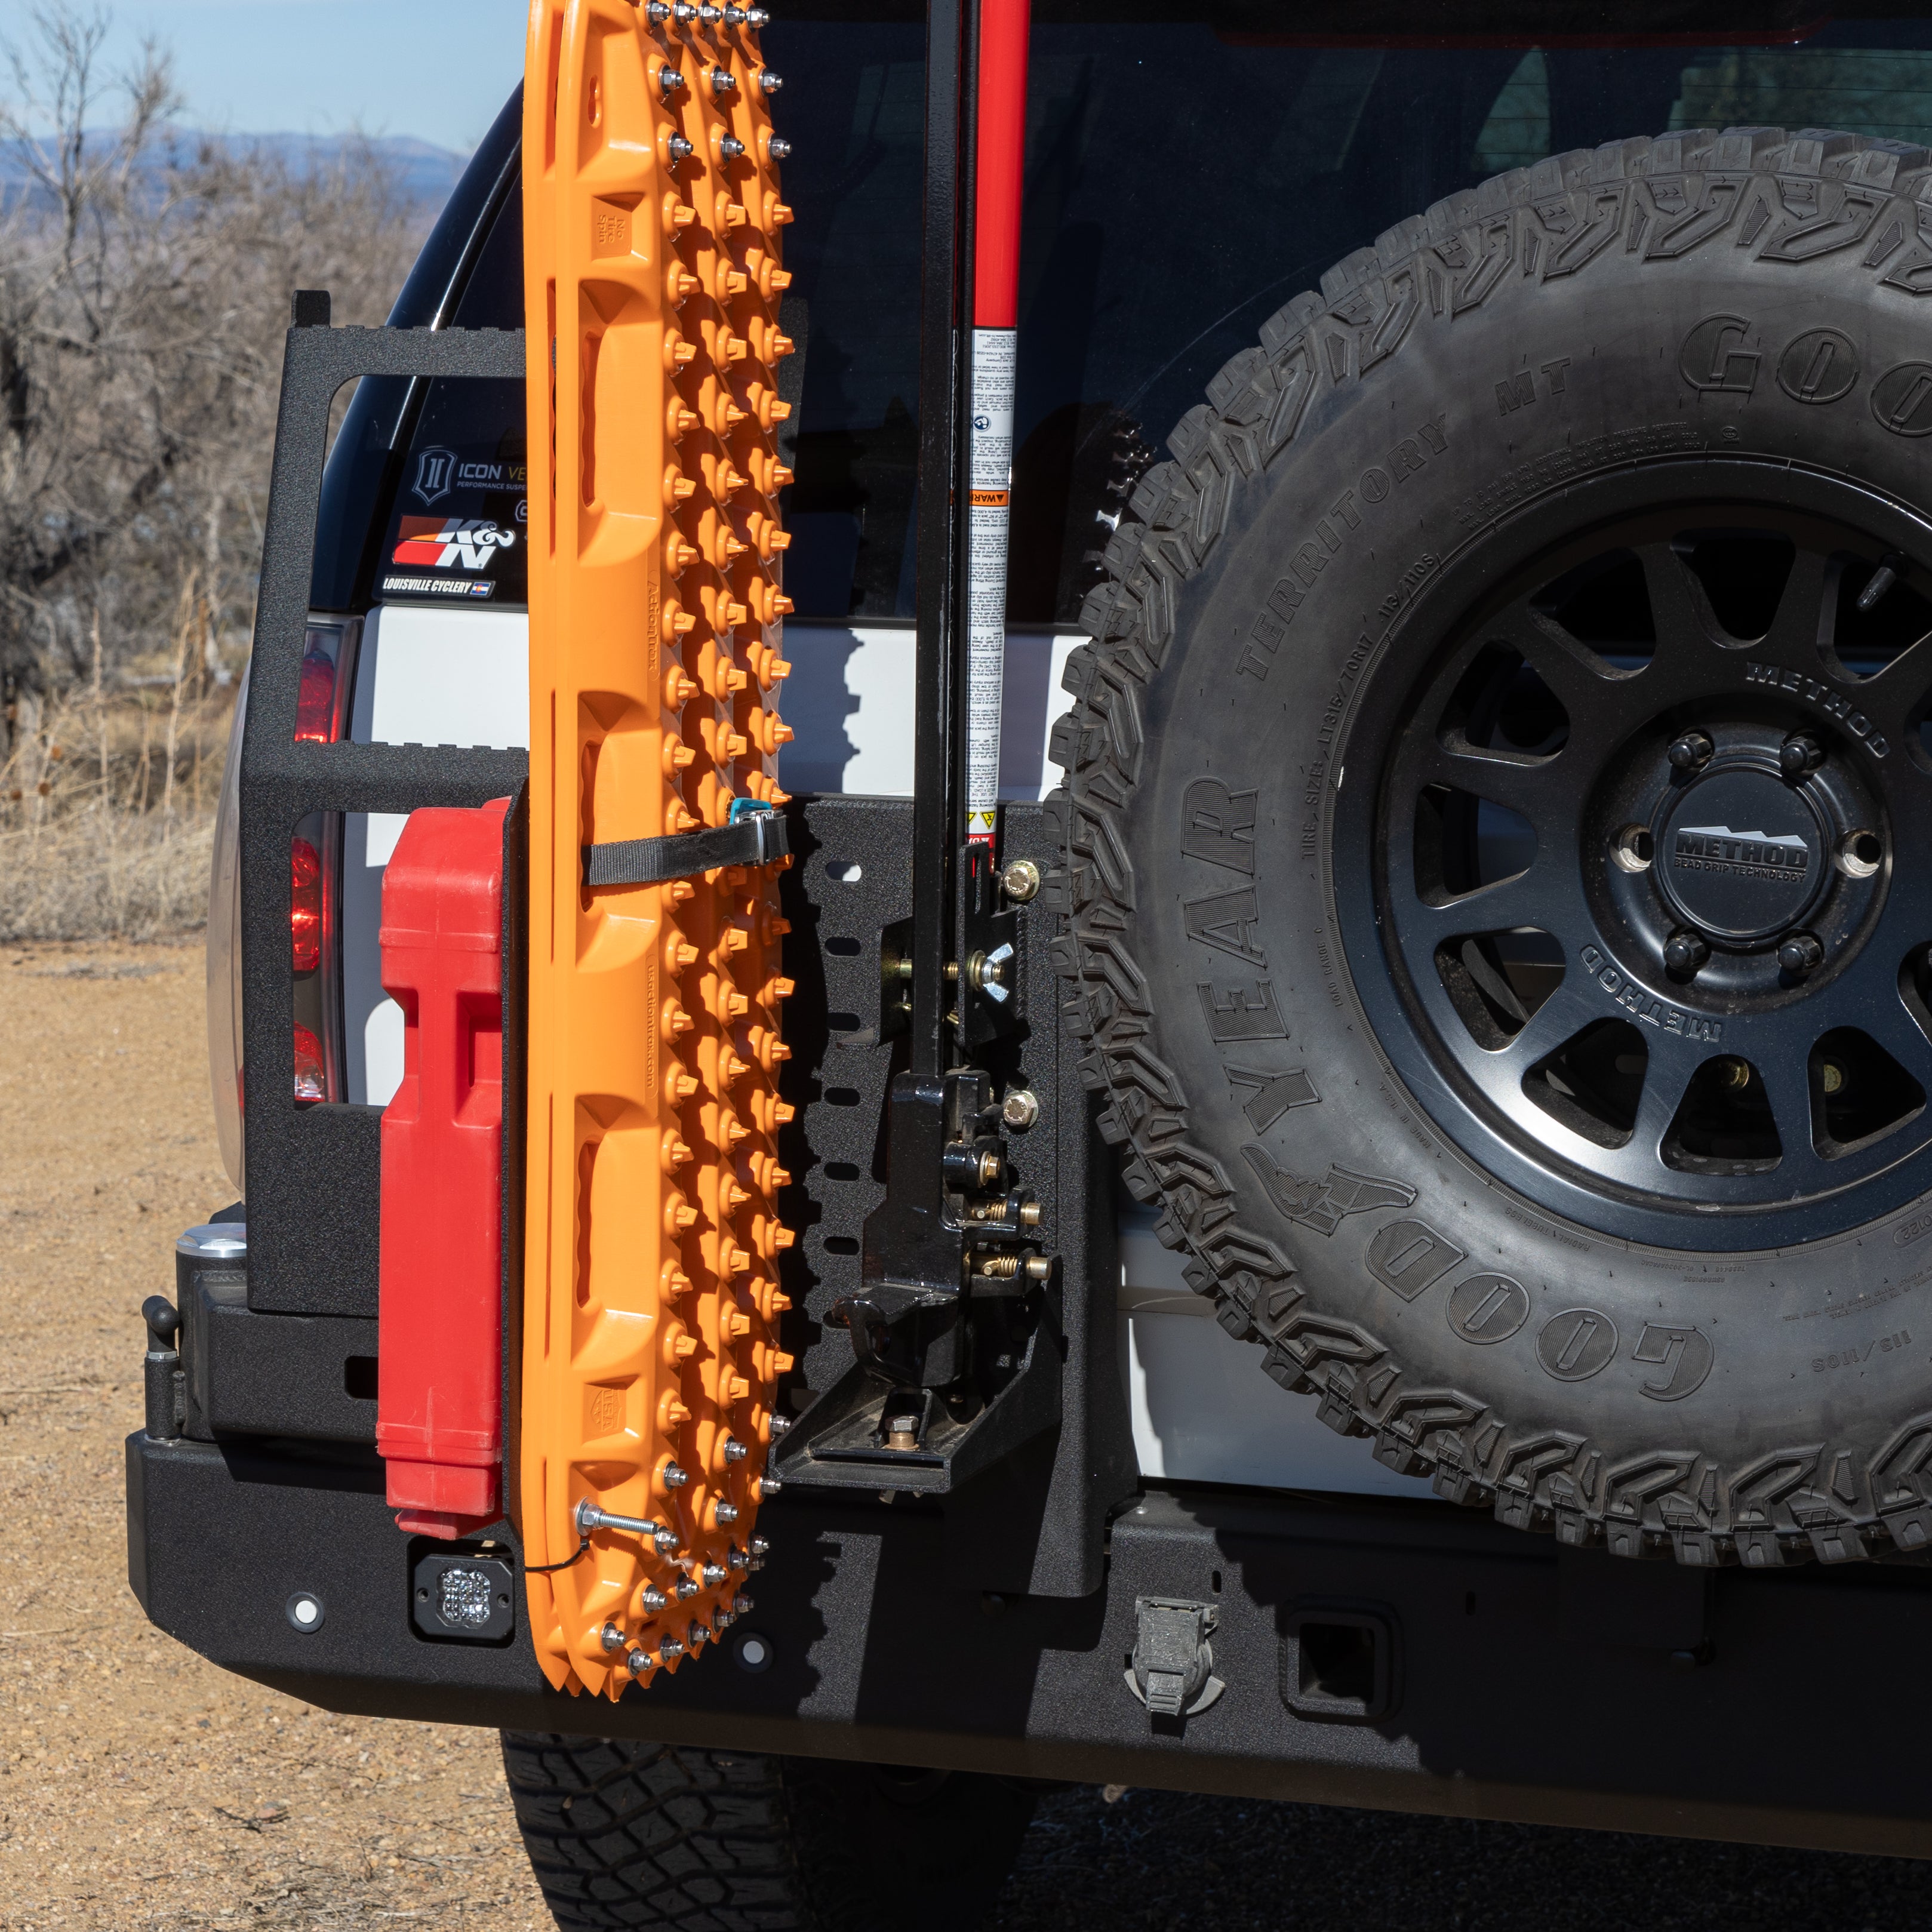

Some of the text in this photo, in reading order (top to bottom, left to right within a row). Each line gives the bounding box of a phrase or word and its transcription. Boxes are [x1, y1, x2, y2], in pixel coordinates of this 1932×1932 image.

[597, 214, 608, 244] Spin
[608, 215, 617, 243] Tire
[617, 219, 626, 240] No
[1536, 447, 1572, 466] ADDITIONAL
[1575, 434, 1608, 449] INFLATION
[1613, 426, 1647, 438] PRESSURE
[1652, 422, 1687, 432] PERMITTED
[457, 481, 504, 490] PERFORMANCE
[458, 463, 502, 479] ICON
[1476, 497, 1493, 512] LOAD
[1681, 431, 1698, 441] COLD
[1236, 413, 1449, 681] TERRITORY
[1494, 357, 1571, 417] MT
[435, 518, 516, 570] K&N
[383, 578, 472, 593] LOUISVILLE CYCLERY
[647, 580, 659, 671] ActionTrax
[1300, 553, 1435, 860] TIRE SIZE: LT315/70R17 113/110S
[1745, 661, 1891, 759] METHOD
[1673, 858, 1807, 884] BEAD GRIP TECHNOLOGY
[1675, 833, 1808, 867] METHOD
[1579, 943, 1723, 1043] METHOD
[647, 965, 657, 1089] usactiontrax.com
[1181, 776, 1714, 1402] GOOD YEAR
[1409, 1125, 1432, 1150] MADE
[1505, 1207, 1591, 1253] RADIAL TUBELESS
[1811, 1330, 1912, 1373] 113/110S
[602, 1390, 614, 1431] USA
